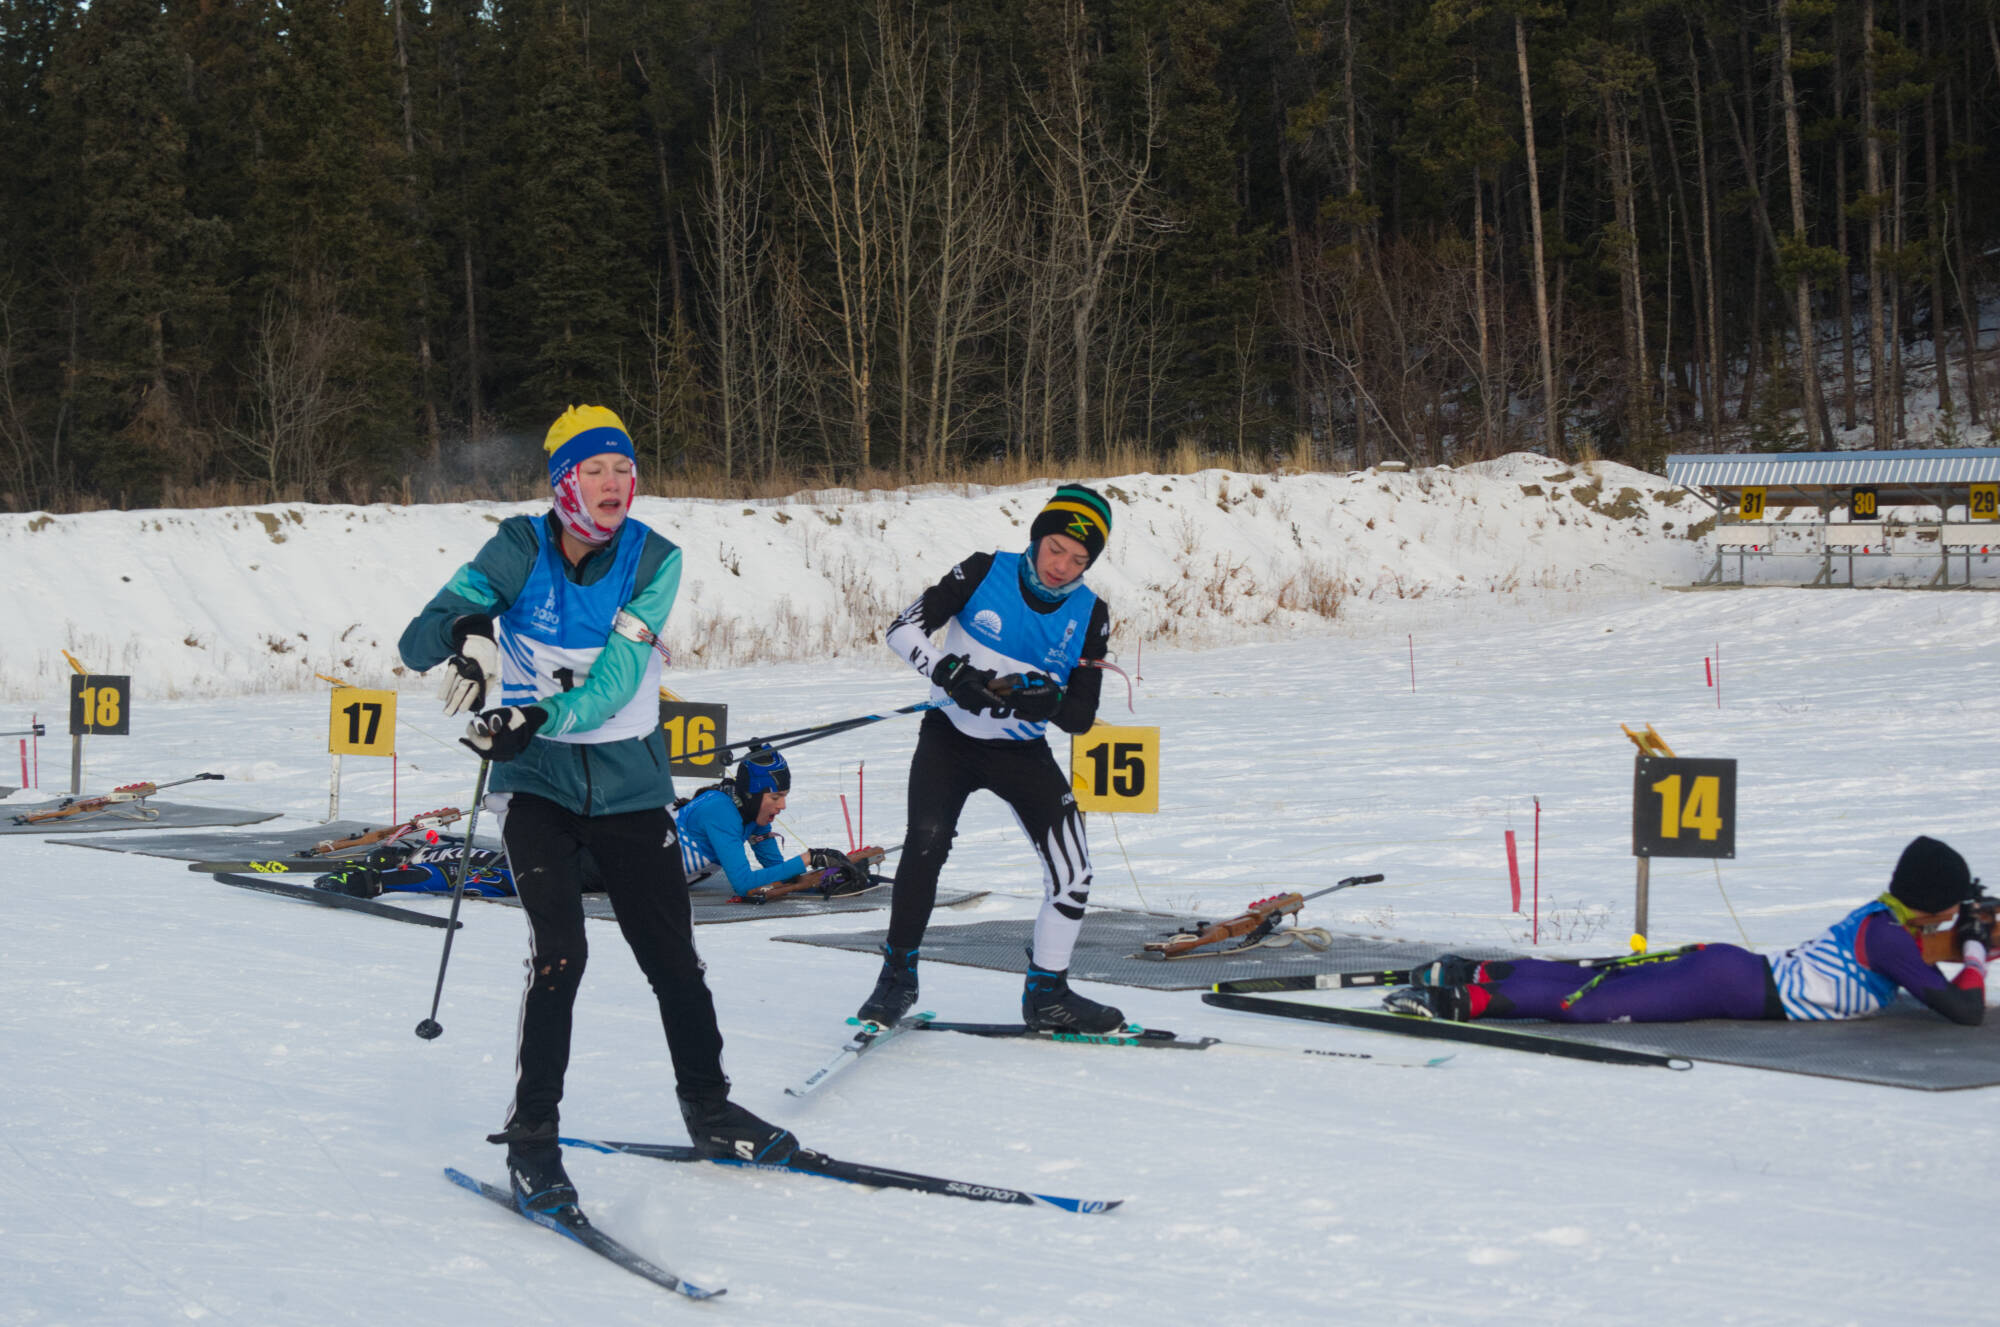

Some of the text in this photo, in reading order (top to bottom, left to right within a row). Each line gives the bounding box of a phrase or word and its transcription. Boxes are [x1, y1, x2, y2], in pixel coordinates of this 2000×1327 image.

[1744, 491, 1763, 513] 31
[1854, 491, 1876, 514] 30
[1973, 490, 1995, 513] 29
[78, 686, 120, 727] 18
[342, 702, 383, 745] 17
[663, 715, 716, 766] 16
[1086, 742, 1145, 797] 15
[1652, 774, 1723, 841] 14
